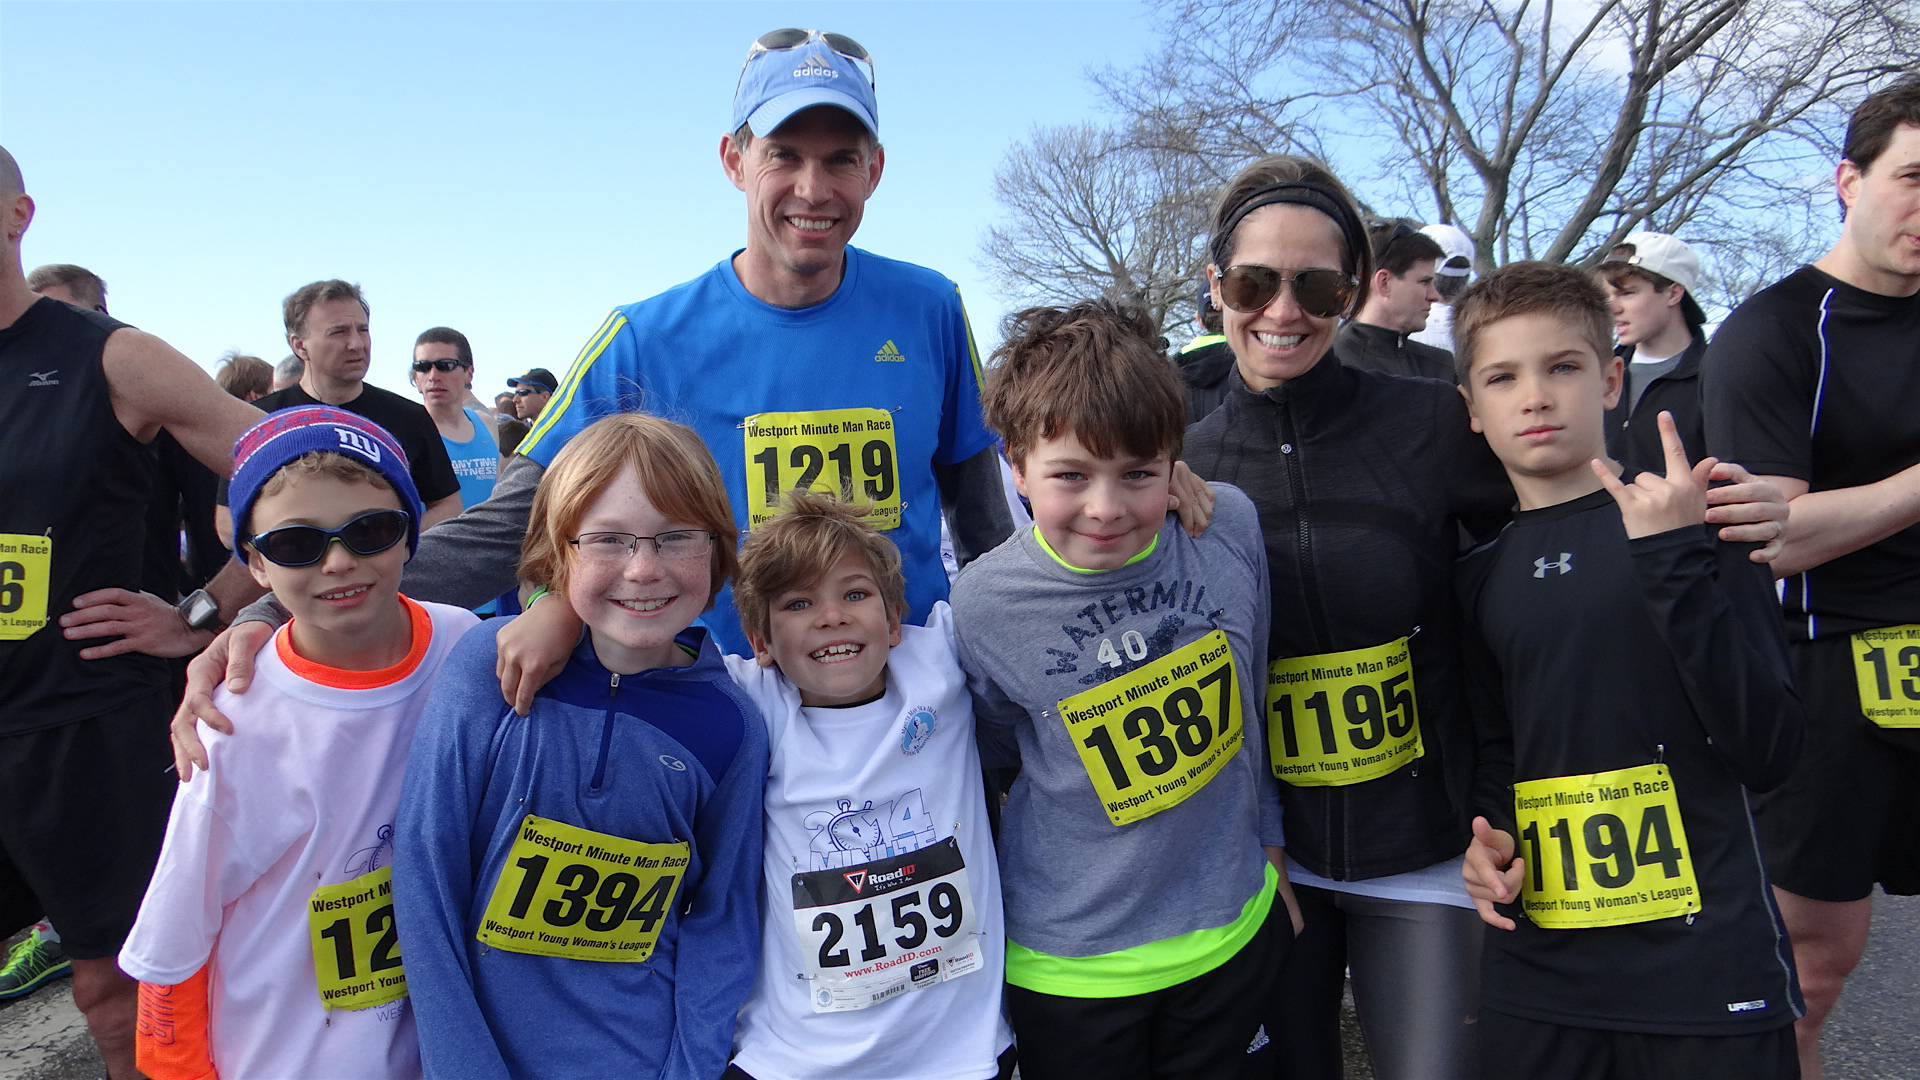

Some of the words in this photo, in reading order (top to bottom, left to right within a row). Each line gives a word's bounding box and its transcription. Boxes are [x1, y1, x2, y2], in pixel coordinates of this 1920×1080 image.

[793, 66, 839, 78] adidas
[874, 354, 906, 362] adidas
[749, 424, 798, 439] Westport
[801, 423, 839, 436] Minute
[842, 421, 867, 433] Man
[867, 419, 891, 431] Race
[451, 457, 497, 469] ANYTIME
[453, 466, 497, 477] FITNESS
[753, 439, 895, 508] 1219
[21, 543, 49, 555] Race
[10, 617, 43, 628] League
[1856, 630, 1904, 641] Westport
[1097, 629, 1148, 668] 40
[1268, 669, 1309, 685] Westport
[1311, 666, 1353, 681] Minute
[1356, 661, 1383, 675] Man
[1386, 650, 1408, 668] Race
[1066, 694, 1125, 725] Westport
[1124, 675, 1170, 702] Minute
[1170, 661, 1199, 681] Man
[1198, 643, 1228, 666] Race
[1083, 661, 1232, 791] 1387
[1272, 671, 1415, 758] 1195
[1866, 706, 1907, 718] Westport
[1274, 762, 1317, 775] Westport
[1317, 761, 1349, 771] Young
[1351, 748, 1393, 768] Woman's
[1394, 735, 1418, 755] League
[1107, 788, 1155, 813] Westport
[1154, 774, 1188, 796] Young
[1187, 749, 1222, 780] Woman's
[1517, 792, 1553, 811] Westport
[1554, 790, 1595, 806] Minute
[1599, 786, 1630, 802] Man
[1633, 780, 1670, 796] Race
[522, 827, 583, 857] Westport
[585, 845, 631, 866] Minute
[633, 855, 659, 869] Man
[661, 856, 688, 868] Race
[1522, 804, 1683, 892] 1194
[312, 887, 376, 913] Westport
[508, 854, 677, 933] 1394
[1525, 899, 1558, 913] Westport
[1558, 898, 1591, 912] Young
[1593, 892, 1648, 909] Woman's
[1650, 885, 1693, 901] League
[485, 919, 535, 940] Westport
[538, 931, 570, 947] Young
[572, 936, 617, 950] Woman's
[618, 940, 652, 952] League
[811, 881, 963, 968] 2159
[844, 945, 943, 978] www.RoadID.com
[323, 980, 375, 1000] Westport
[378, 973, 406, 990] Youn
[1246, 1035, 1270, 1054] adidas
